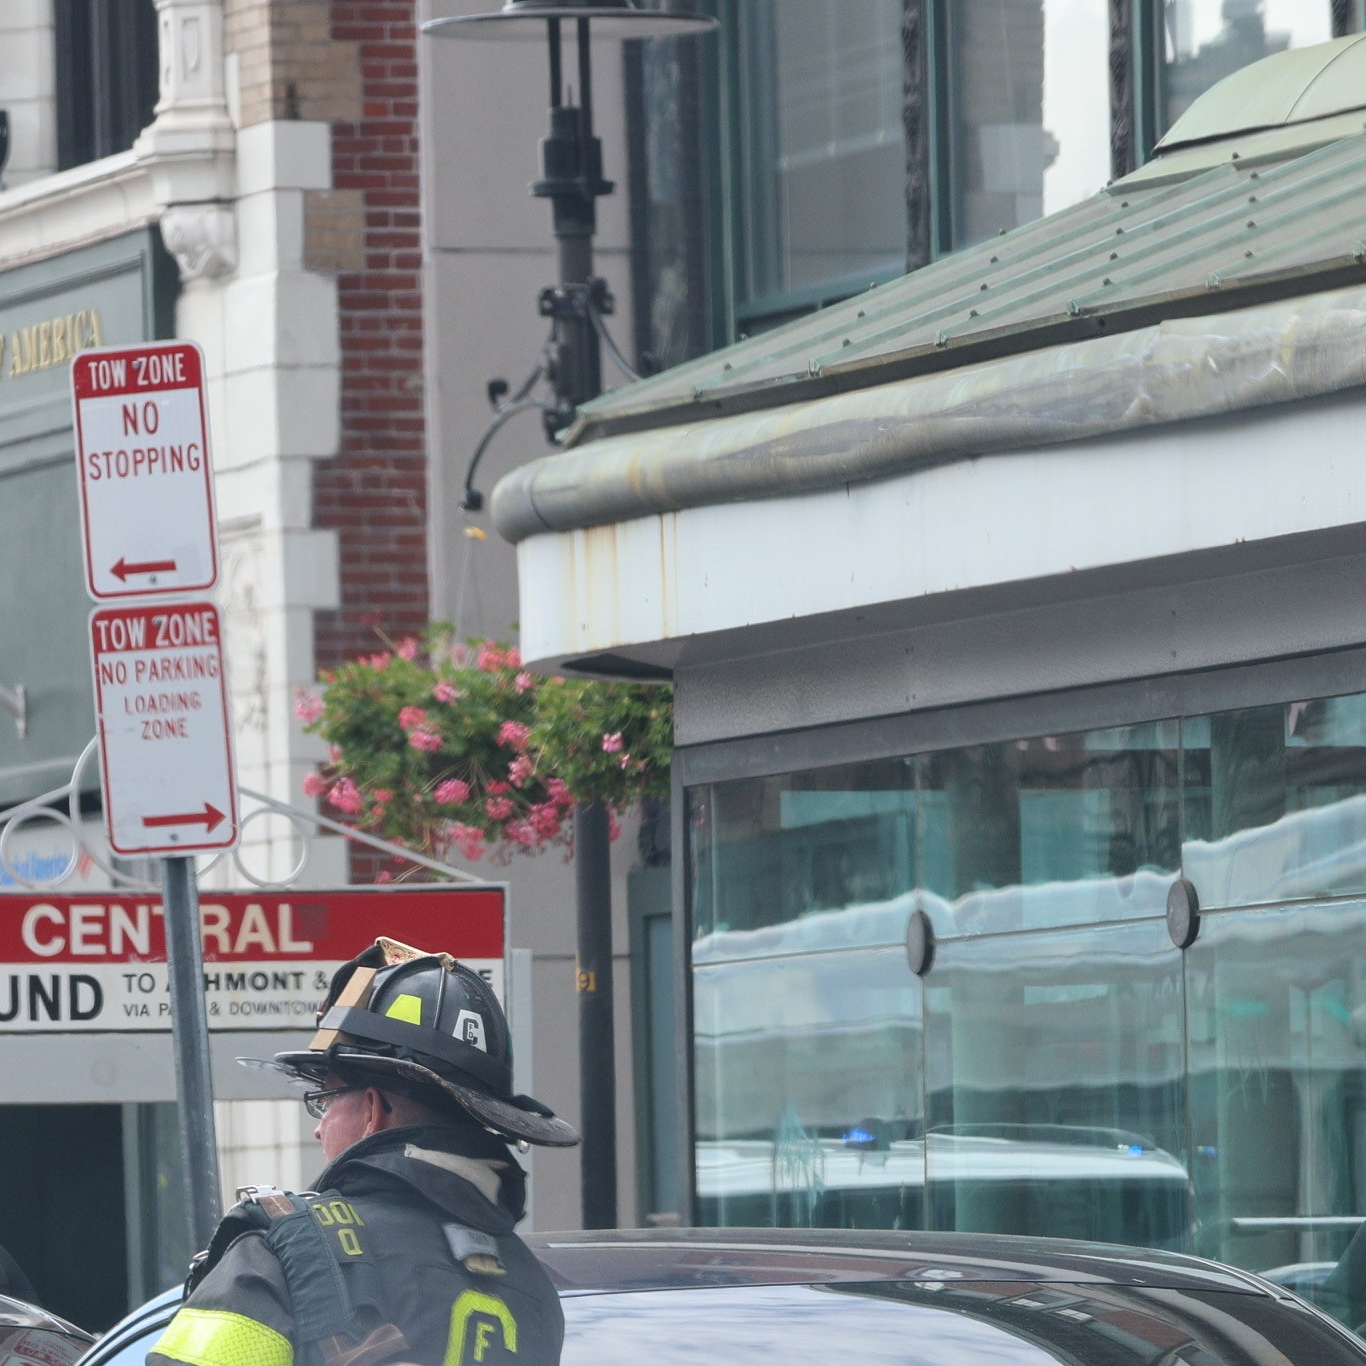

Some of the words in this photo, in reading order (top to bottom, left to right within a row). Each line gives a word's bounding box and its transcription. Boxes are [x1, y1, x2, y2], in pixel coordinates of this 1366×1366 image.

[10, 309, 103, 377] AMERICA
[88, 360, 126, 390] TOW
[136, 353, 186, 386] ZONE
[122, 401, 159, 436] NO
[89, 443, 201, 480] STOPPING
[96, 617, 145, 650] TOW
[152, 611, 218, 647] ZONE
[101, 661, 127, 685] NO
[134, 655, 219, 682] PARKING
[124, 692, 203, 715] LOADING
[141, 718, 189, 741] ZONE
[21, 903, 314, 957] CENRAL
[123, 972, 156, 993] TO
[166, 971, 305, 993] HMONT
[123, 1002, 150, 1017] VIA
[209, 1001, 221, 1016] &
[229, 1001, 323, 1016] DOWNTOW
